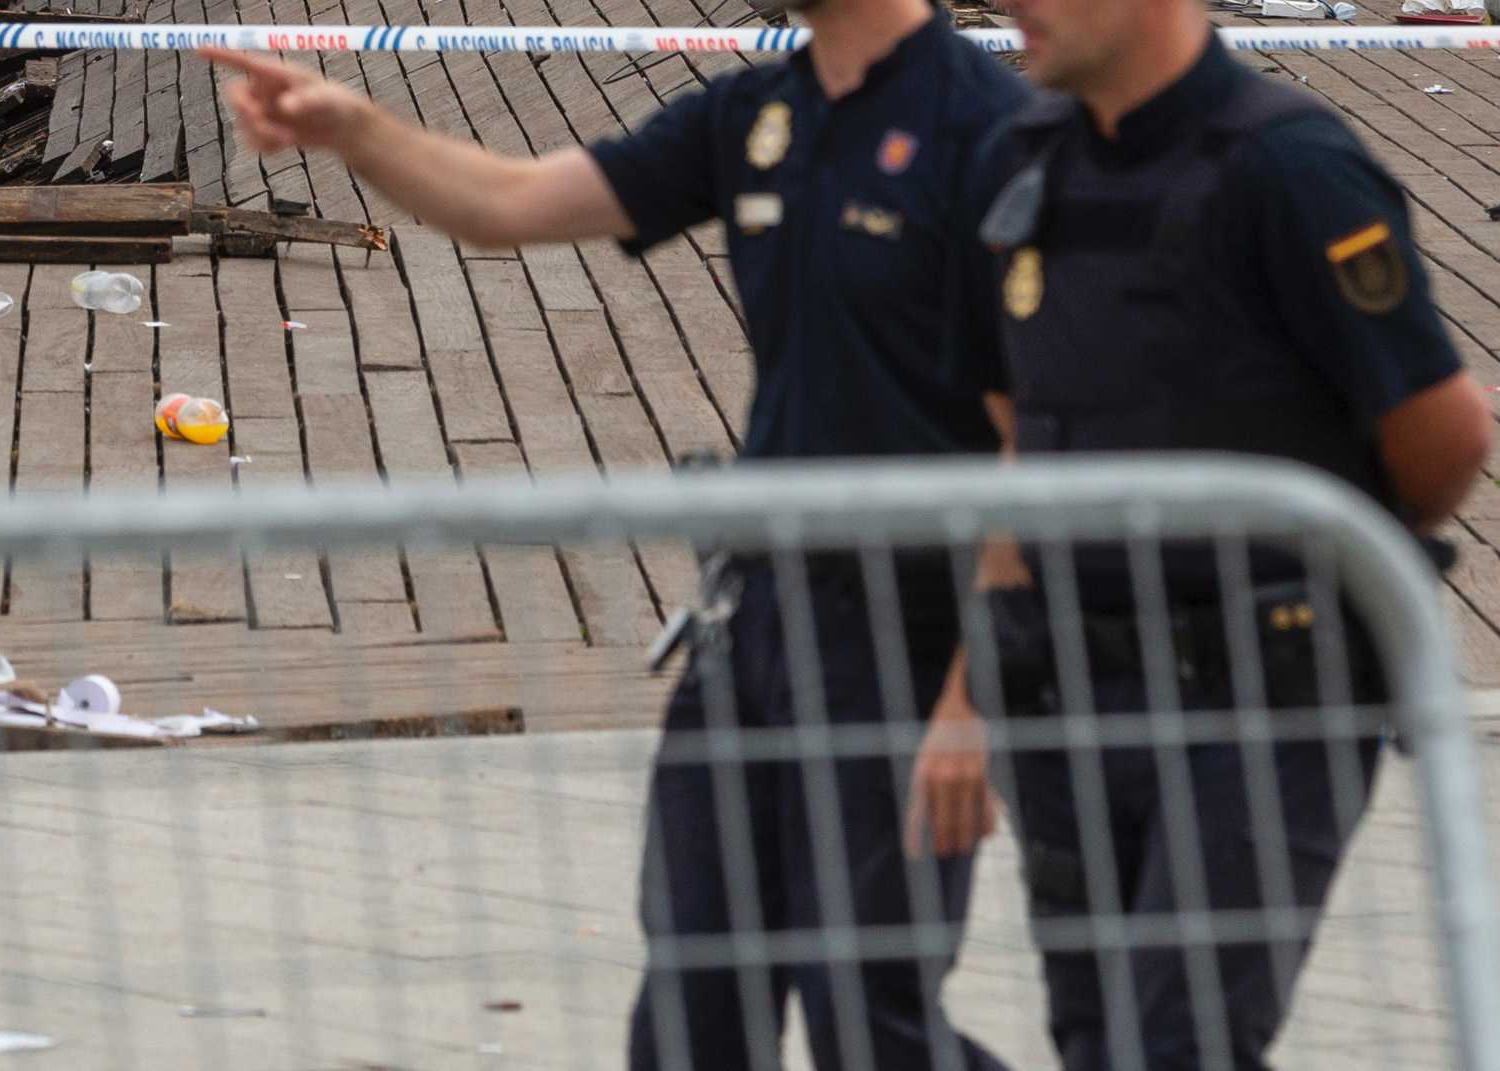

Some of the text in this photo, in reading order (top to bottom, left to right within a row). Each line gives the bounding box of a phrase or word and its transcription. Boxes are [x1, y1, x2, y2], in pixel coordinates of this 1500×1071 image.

[56, 31, 134, 48] NACIONAL
[141, 32, 160, 49] DE
[166, 32, 229, 49] POLICIA
[267, 34, 291, 50] NO
[296, 34, 348, 50] PASAR
[437, 35, 519, 51] NACIONAL
[524, 36, 545, 51] DE
[551, 36, 615, 51] POLICIA
